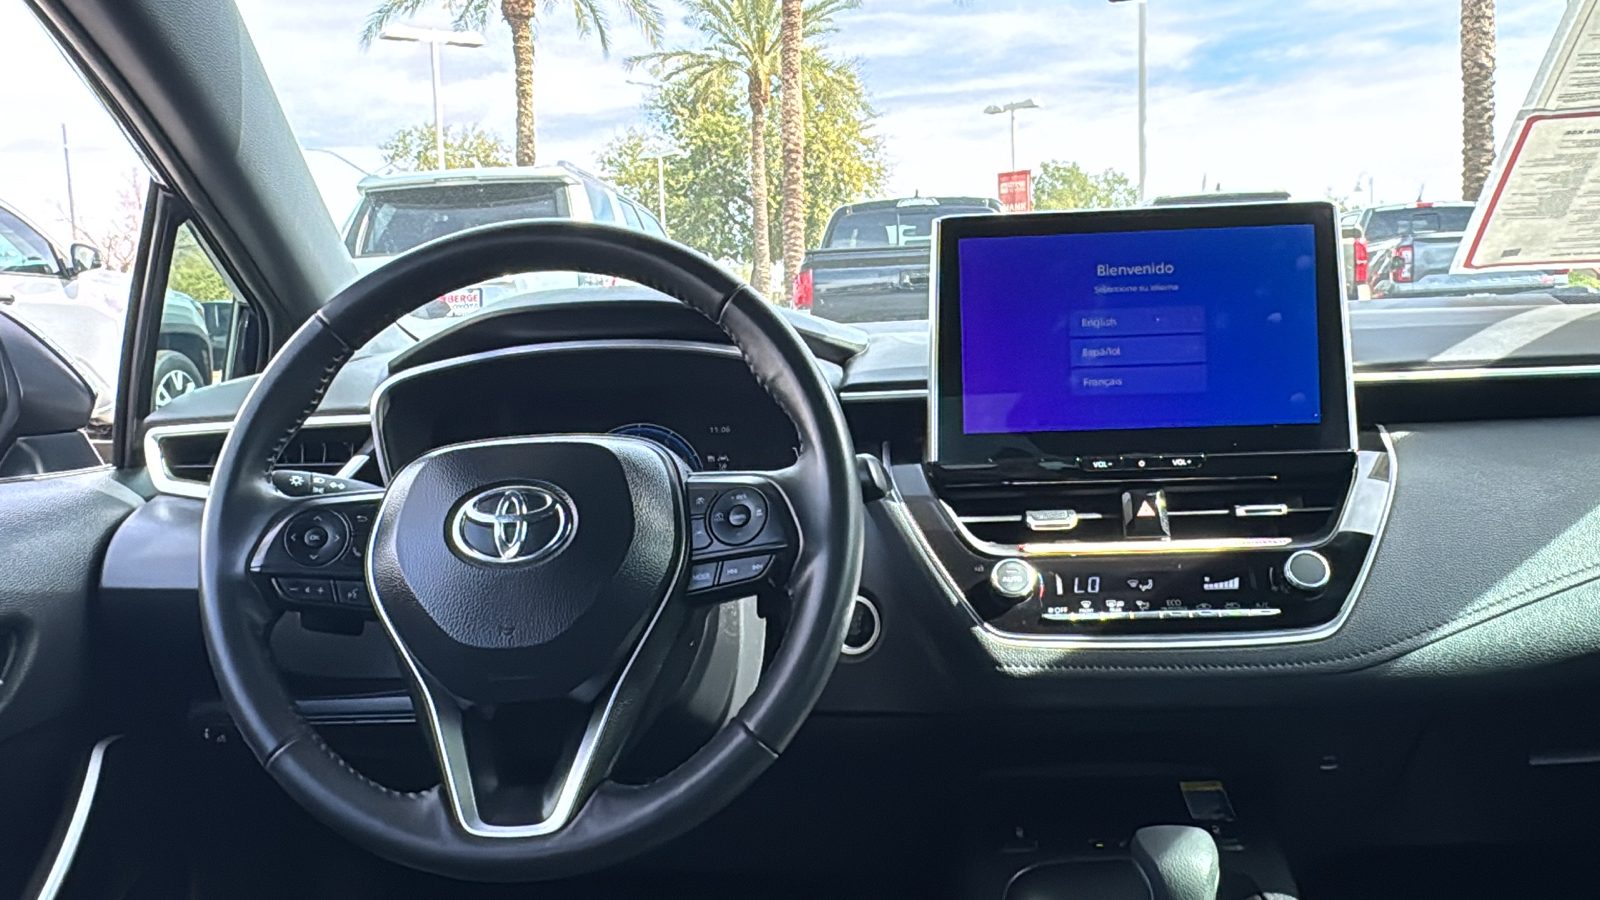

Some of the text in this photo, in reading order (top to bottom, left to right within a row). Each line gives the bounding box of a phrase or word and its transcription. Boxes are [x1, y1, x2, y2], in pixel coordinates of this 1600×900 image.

[1096, 262, 1174, 277] Bienvenido
[447, 294, 478, 303] BERGE
[1081, 318, 1117, 328] English
[1081, 347, 1121, 358] Español
[1083, 377, 1122, 387] Français
[1166, 599, 1182, 607] ECO
